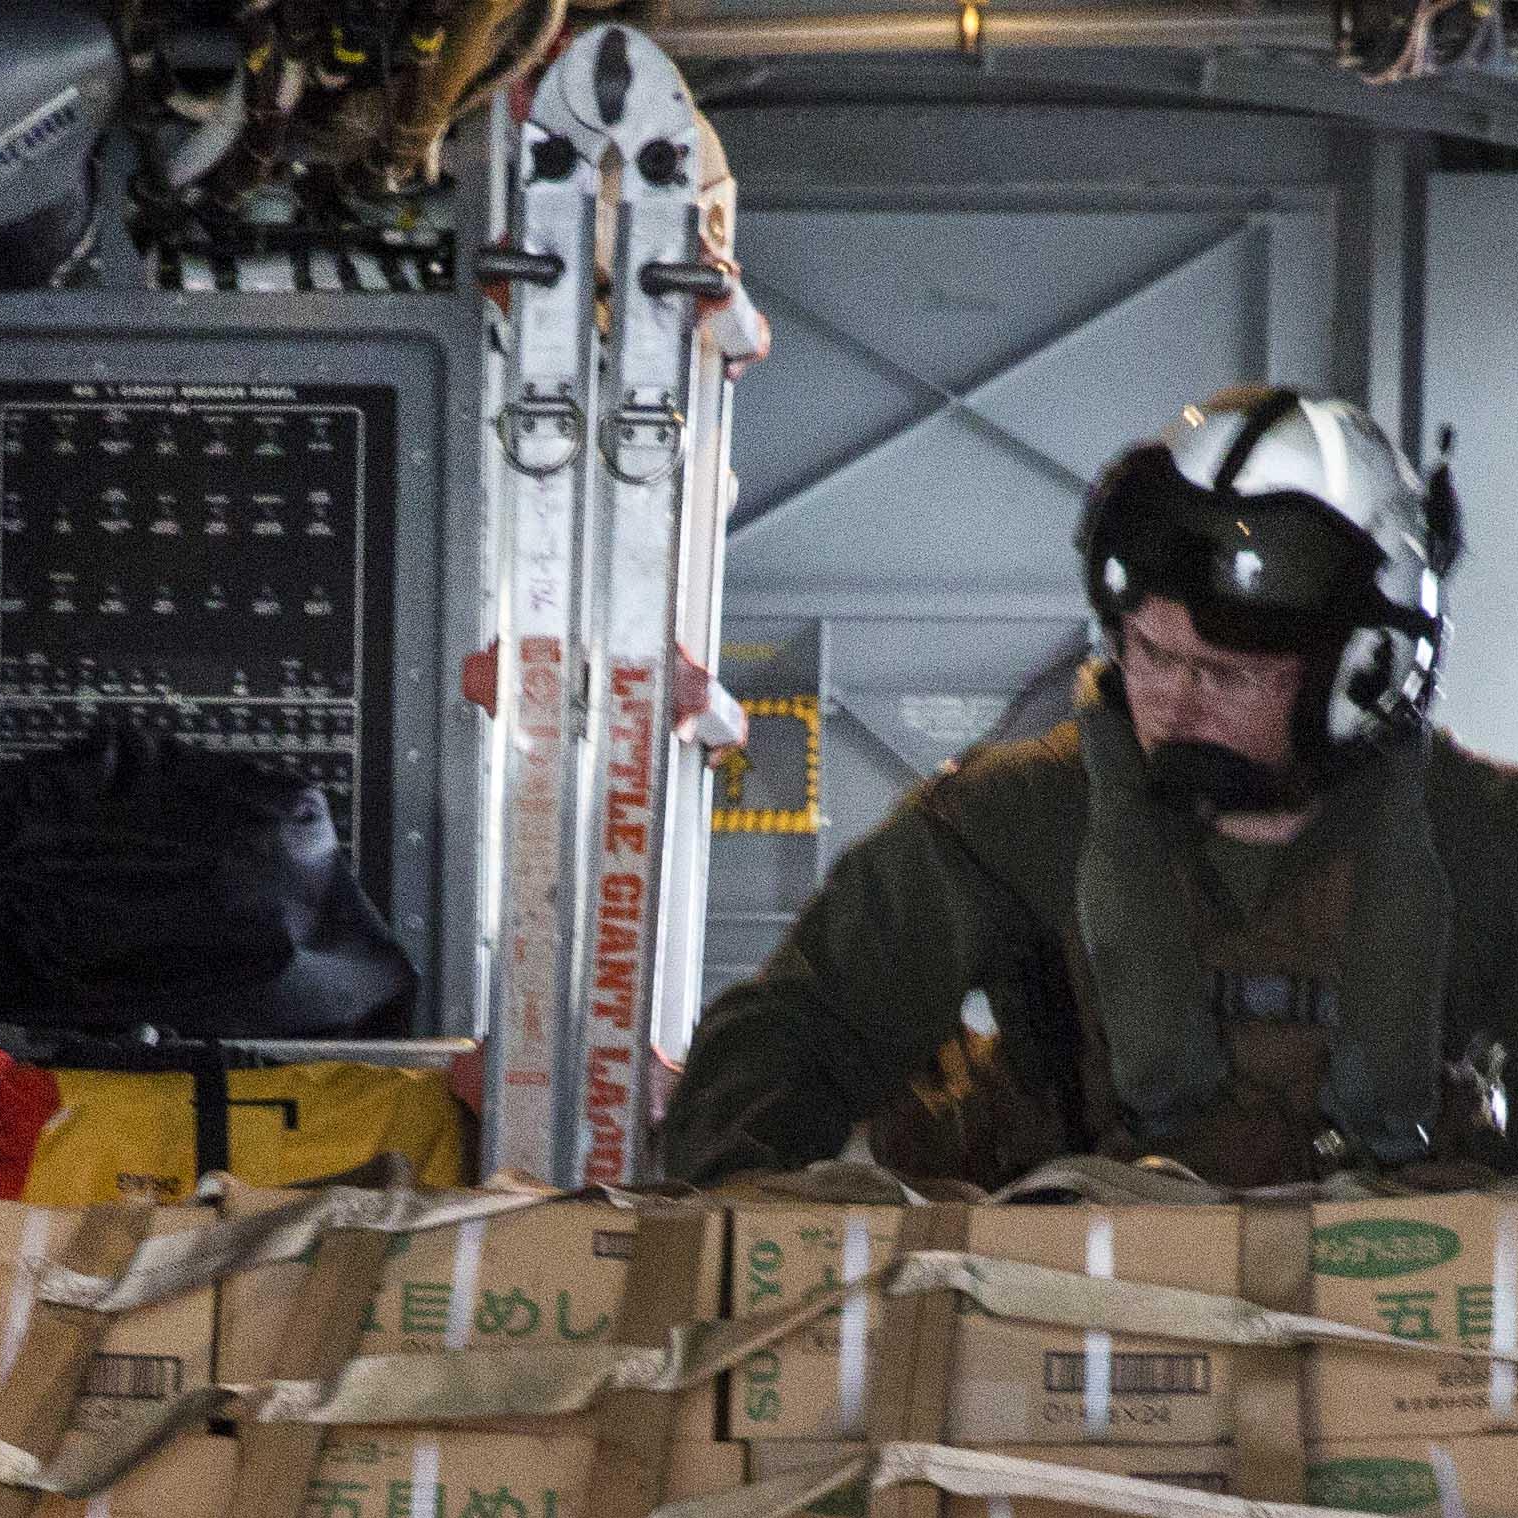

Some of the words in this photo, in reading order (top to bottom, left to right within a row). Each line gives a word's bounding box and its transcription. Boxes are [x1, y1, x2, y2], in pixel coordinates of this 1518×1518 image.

[593, 874, 647, 1032] GIANT
[363, 1280, 611, 1342] 目めし
[746, 1238, 784, 1424] SUYO
